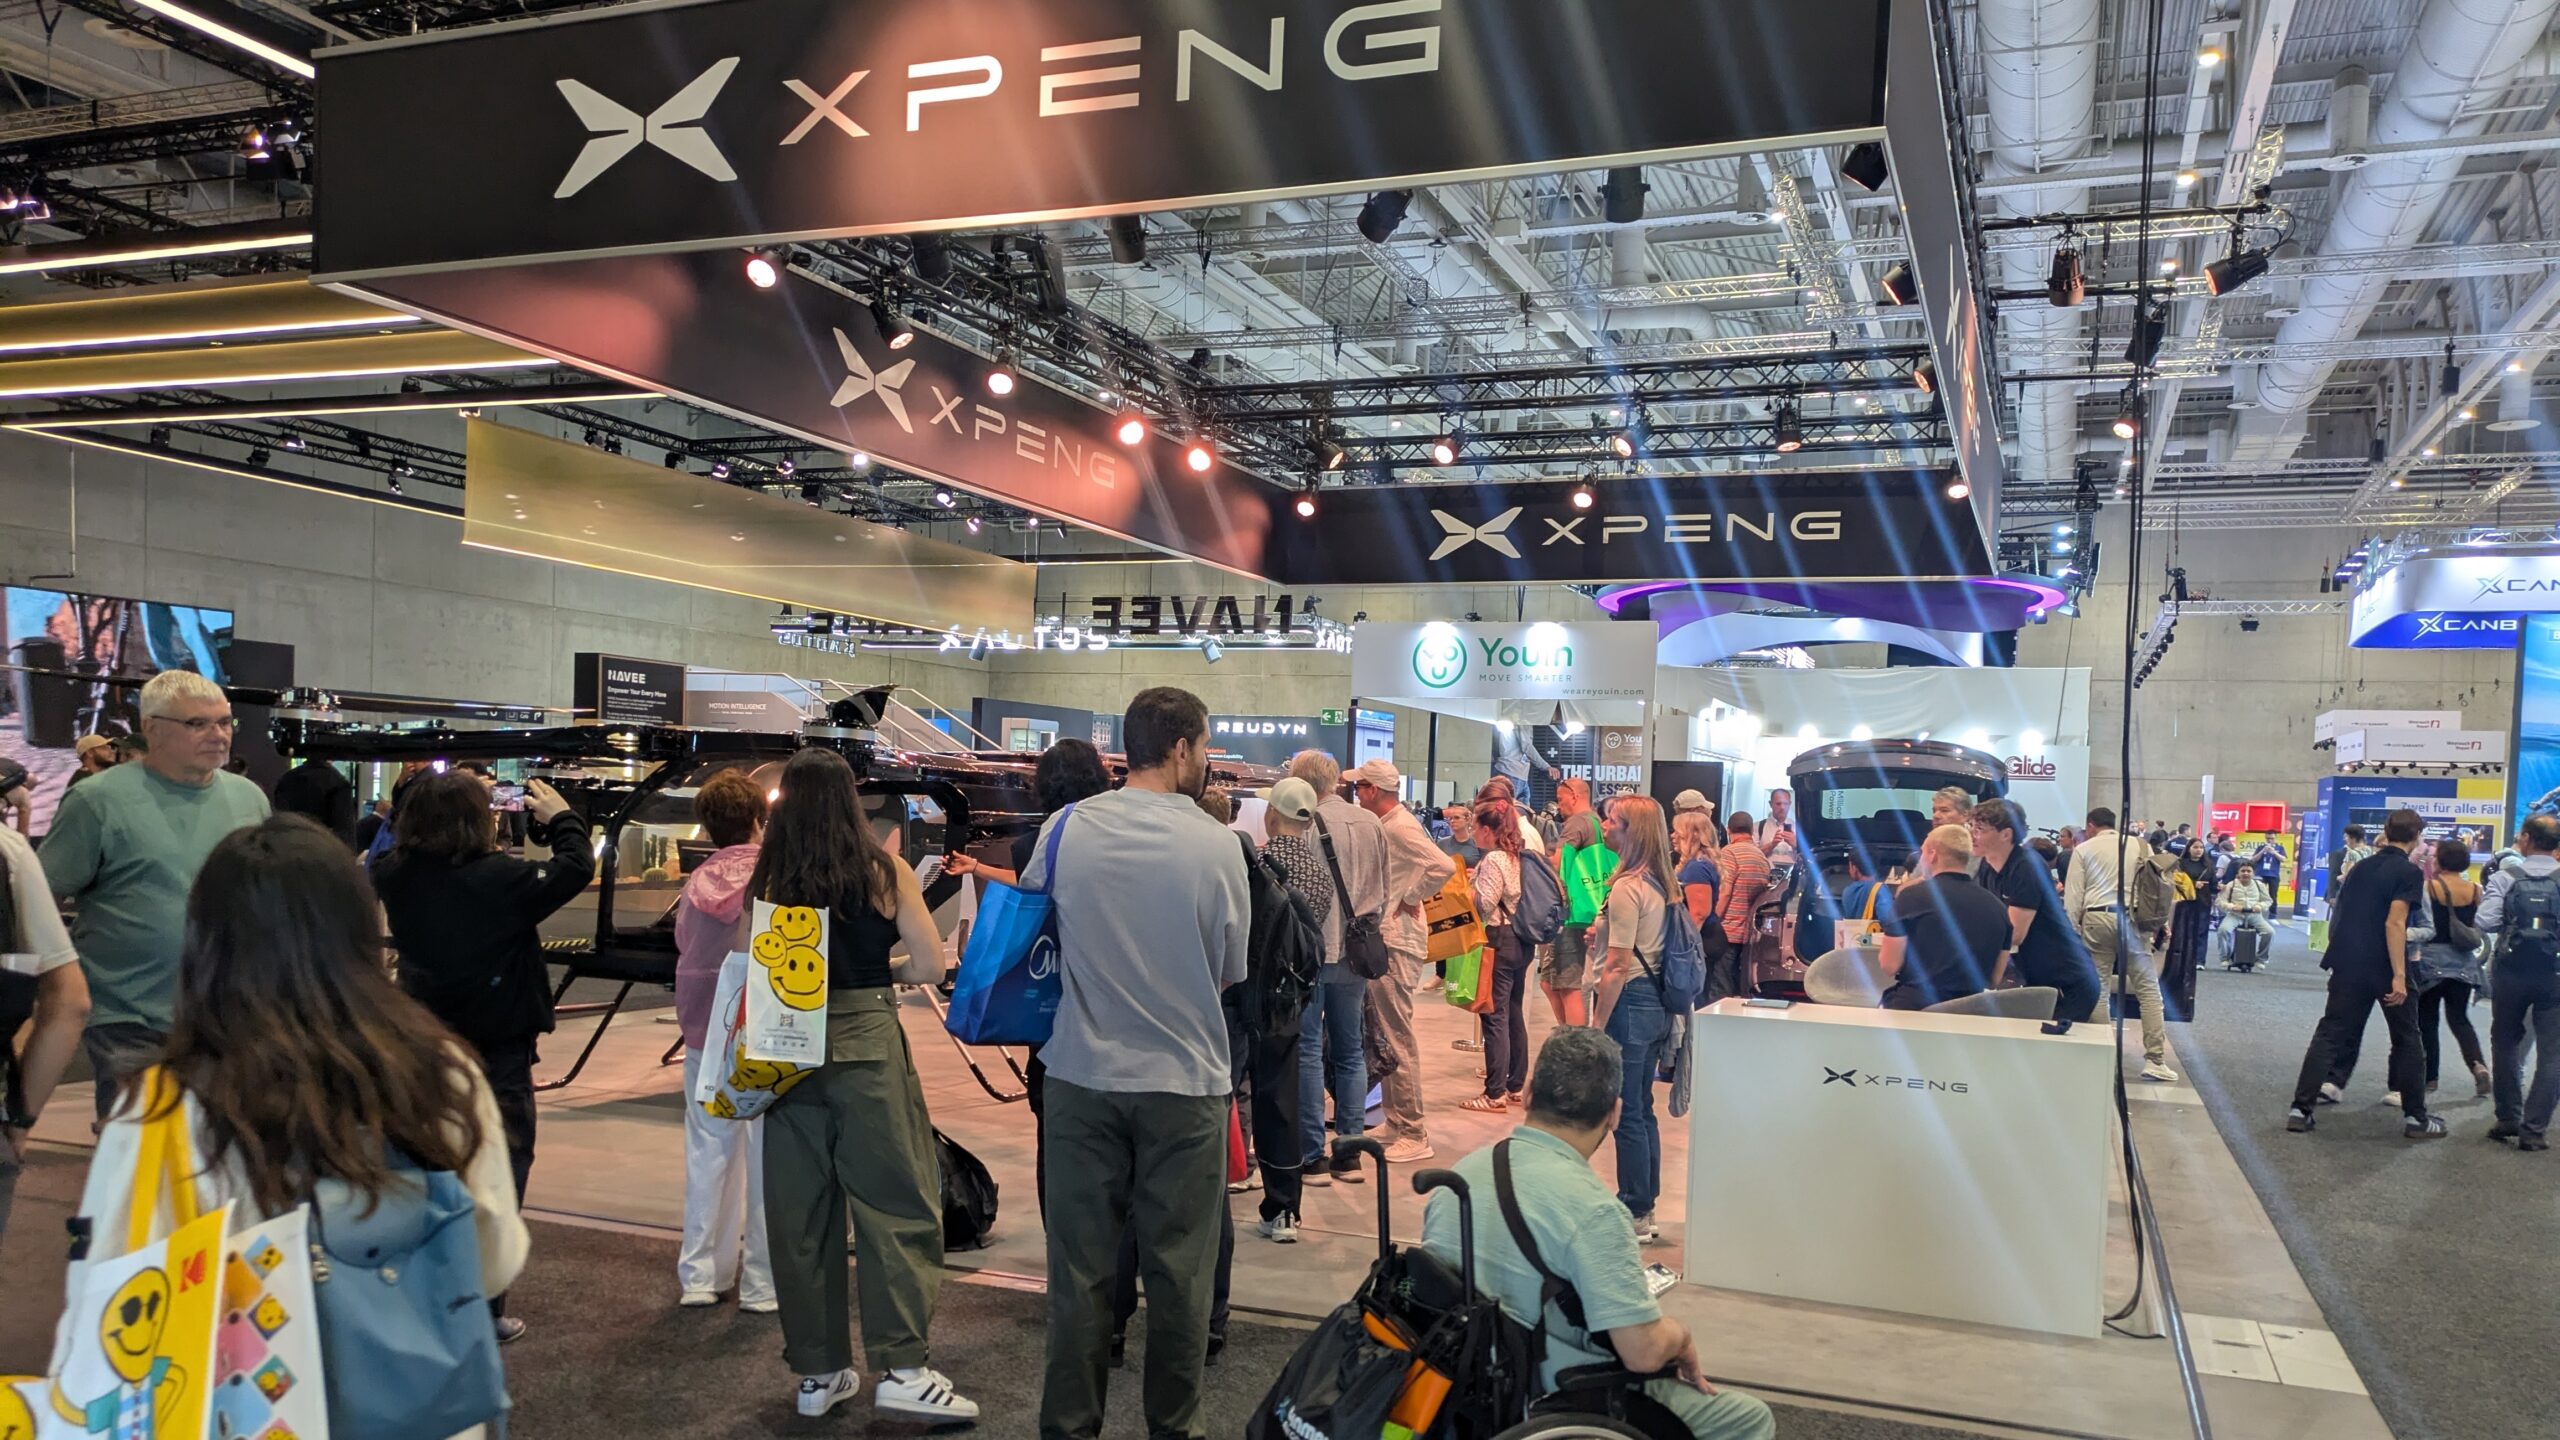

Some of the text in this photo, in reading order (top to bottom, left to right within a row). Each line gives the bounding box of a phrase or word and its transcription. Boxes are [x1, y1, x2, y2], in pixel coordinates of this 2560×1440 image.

[778, 0, 1443, 146] XPENG
[929, 385, 1118, 490] XPENG
[1541, 510, 1842, 545] XPENG
[607, 669, 647, 684] NAVEE
[1479, 674, 1572, 682] MOVE SMARTER
[1562, 687, 1645, 697] weareyouin.com
[1216, 721, 1307, 735] REUDYN
[1561, 764, 1592, 781] THE
[2004, 755, 2056, 776] Glide
[2434, 802, 2451, 813] für
[2455, 803, 2477, 814] alle
[2481, 804, 2505, 815] Fäll
[1581, 871, 1612, 886] PLA
[1865, 1074, 1969, 1094] XPENG
